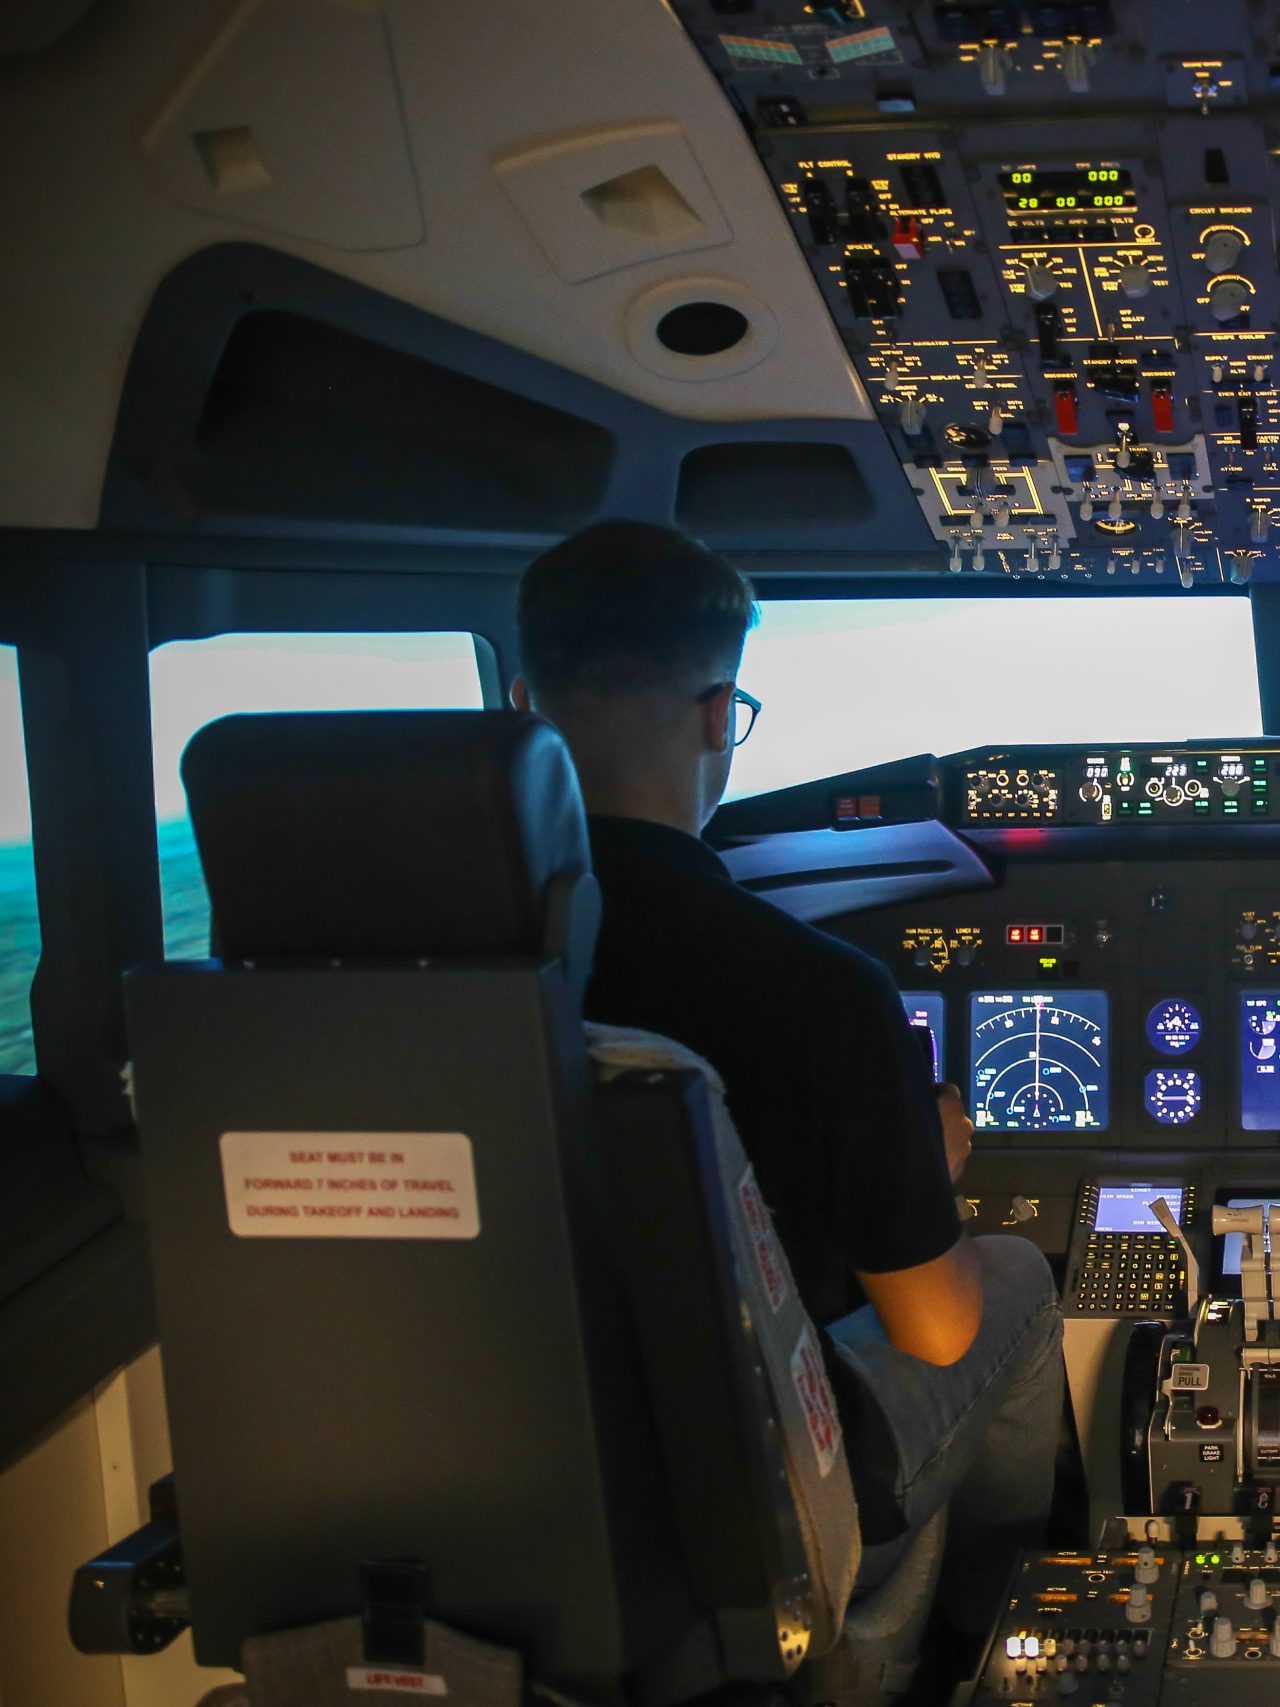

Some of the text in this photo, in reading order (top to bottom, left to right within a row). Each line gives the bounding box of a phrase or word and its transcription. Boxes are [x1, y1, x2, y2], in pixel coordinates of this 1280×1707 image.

[1012, 173, 1032, 183] 00
[1088, 171, 1118, 181] 000
[1019, 196, 1123, 208] 28 00 000
[290, 1152, 403, 1163] SEAT MUST BE IN
[245, 1179, 312, 1190] FORWARD
[328, 1180, 376, 1190] INCHES
[380, 1180, 399, 1190] OF
[403, 1180, 454, 1191] TRAVEL
[247, 1206, 459, 1218] DURING TAKEOFF AND LANDING
[1178, 1377, 1201, 1386] PULL
[1185, 1493, 1193, 1510] 1
